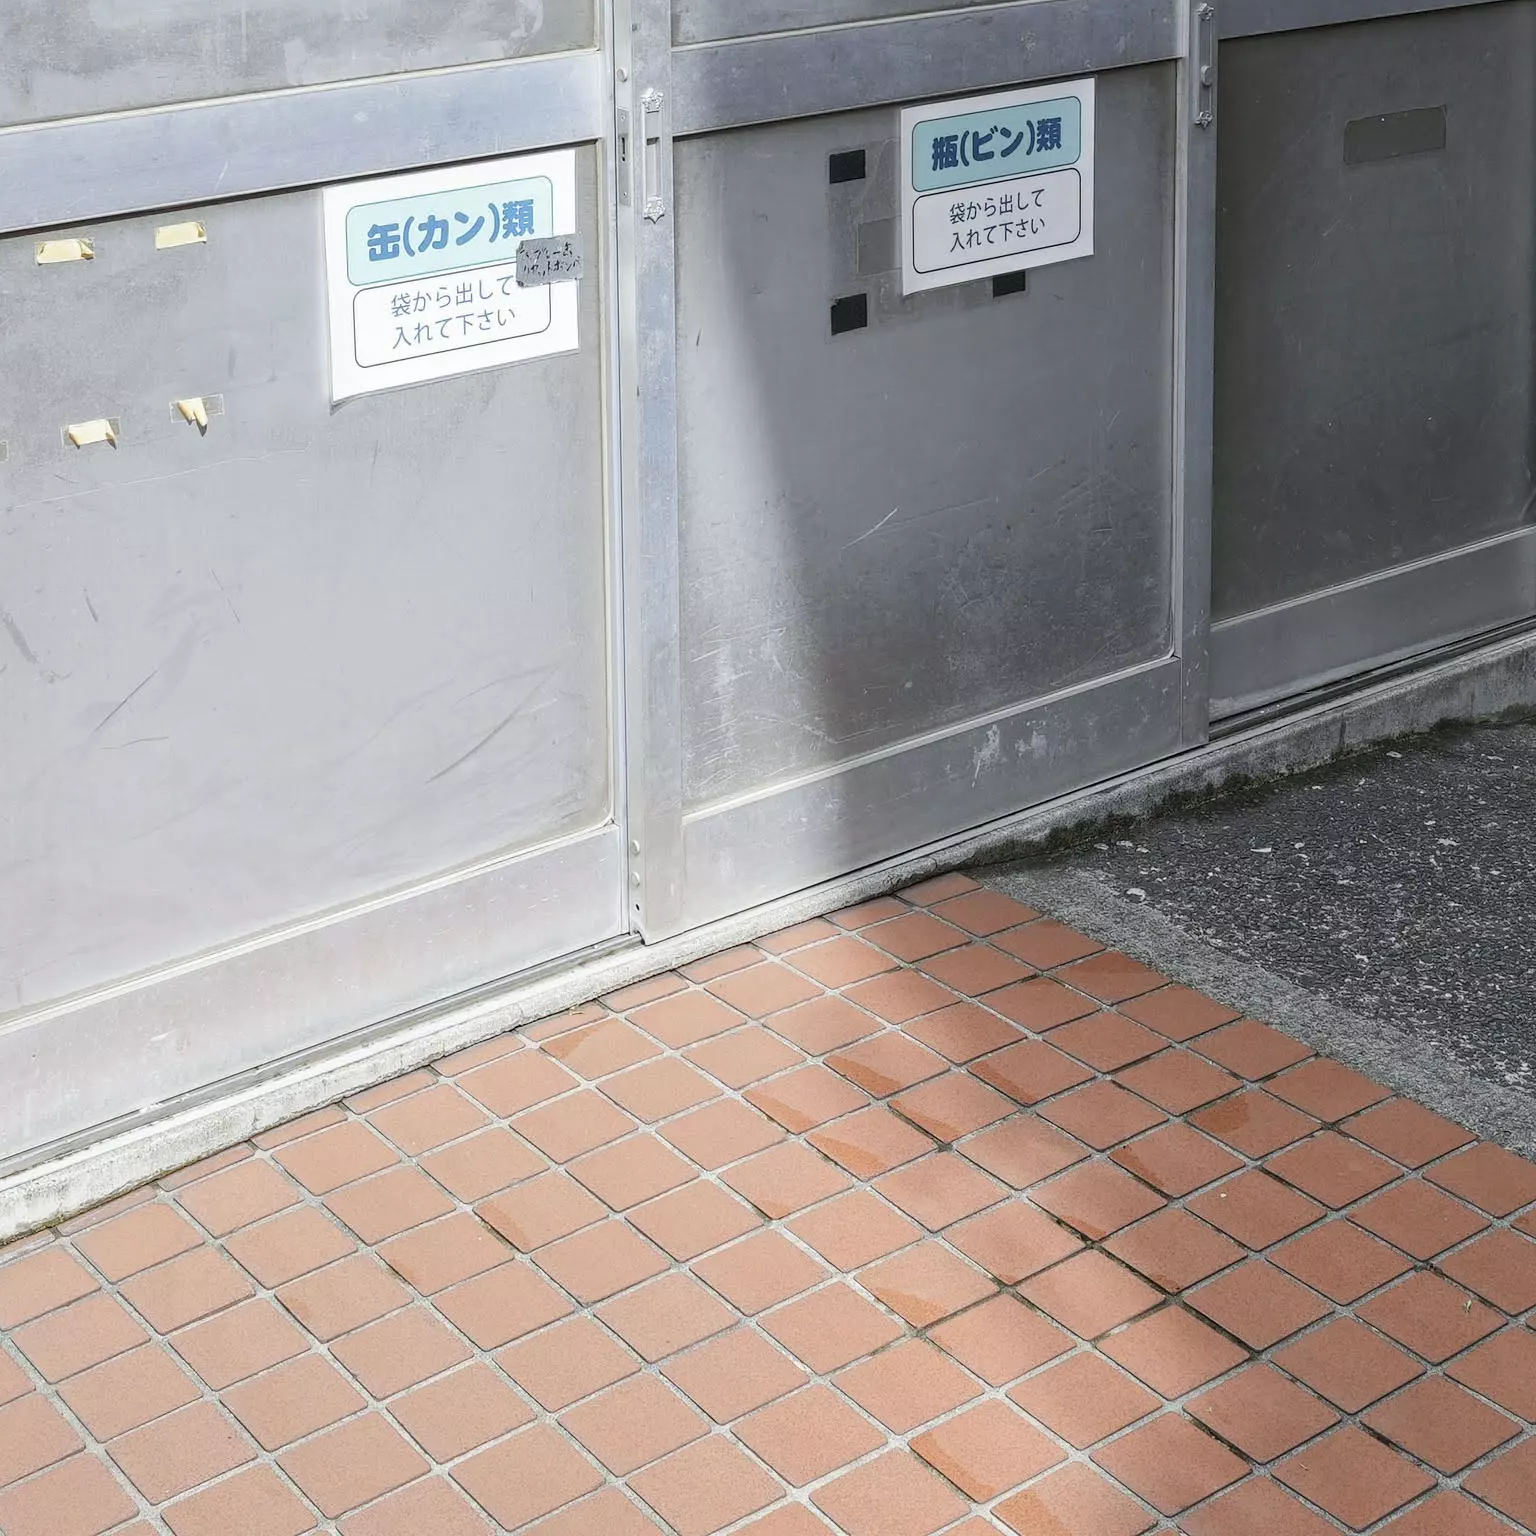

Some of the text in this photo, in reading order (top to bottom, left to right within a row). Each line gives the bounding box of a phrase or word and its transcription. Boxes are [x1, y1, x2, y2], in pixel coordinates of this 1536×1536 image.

[932, 116, 1062, 171] 瓶(ビン)類
[949, 188, 1046, 225] 袋から出して
[367, 198, 535, 262] 缶(カン)類
[949, 217, 1046, 253] 入れて下さい
[390, 275, 514, 319] 袋から出して
[392, 308, 516, 350] 入れて下さい
